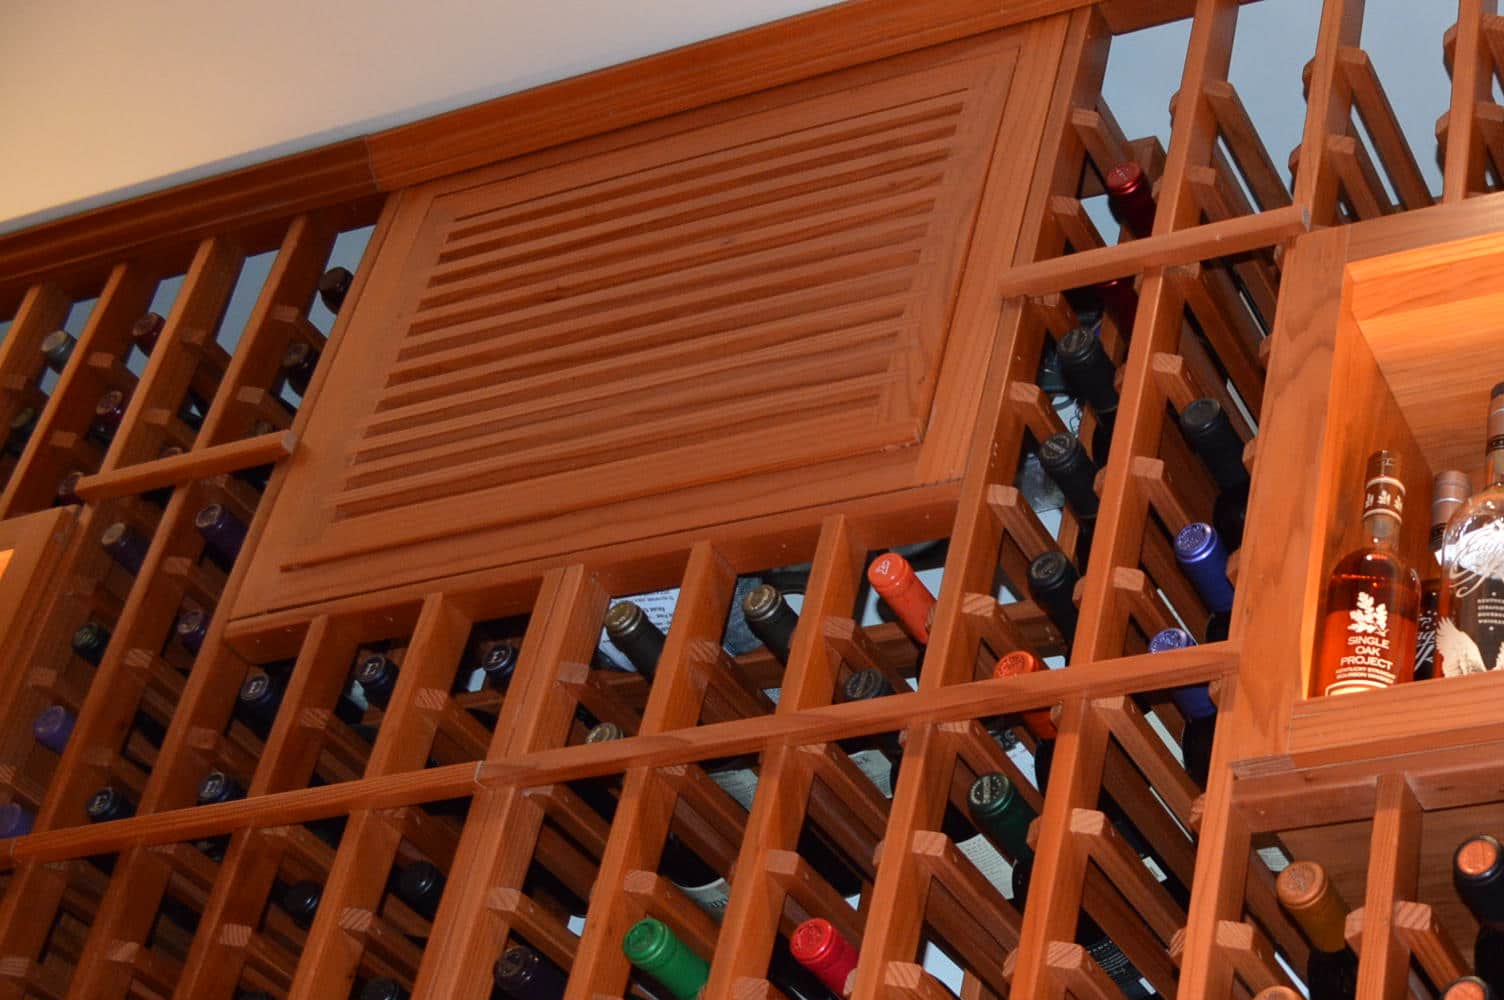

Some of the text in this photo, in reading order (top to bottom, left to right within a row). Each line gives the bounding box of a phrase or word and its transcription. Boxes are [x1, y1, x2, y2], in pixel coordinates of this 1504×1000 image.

[1347, 635, 1390, 650] SINGLE
[1355, 645, 1381, 656] OAK
[1340, 655, 1393, 670] PROJECT
